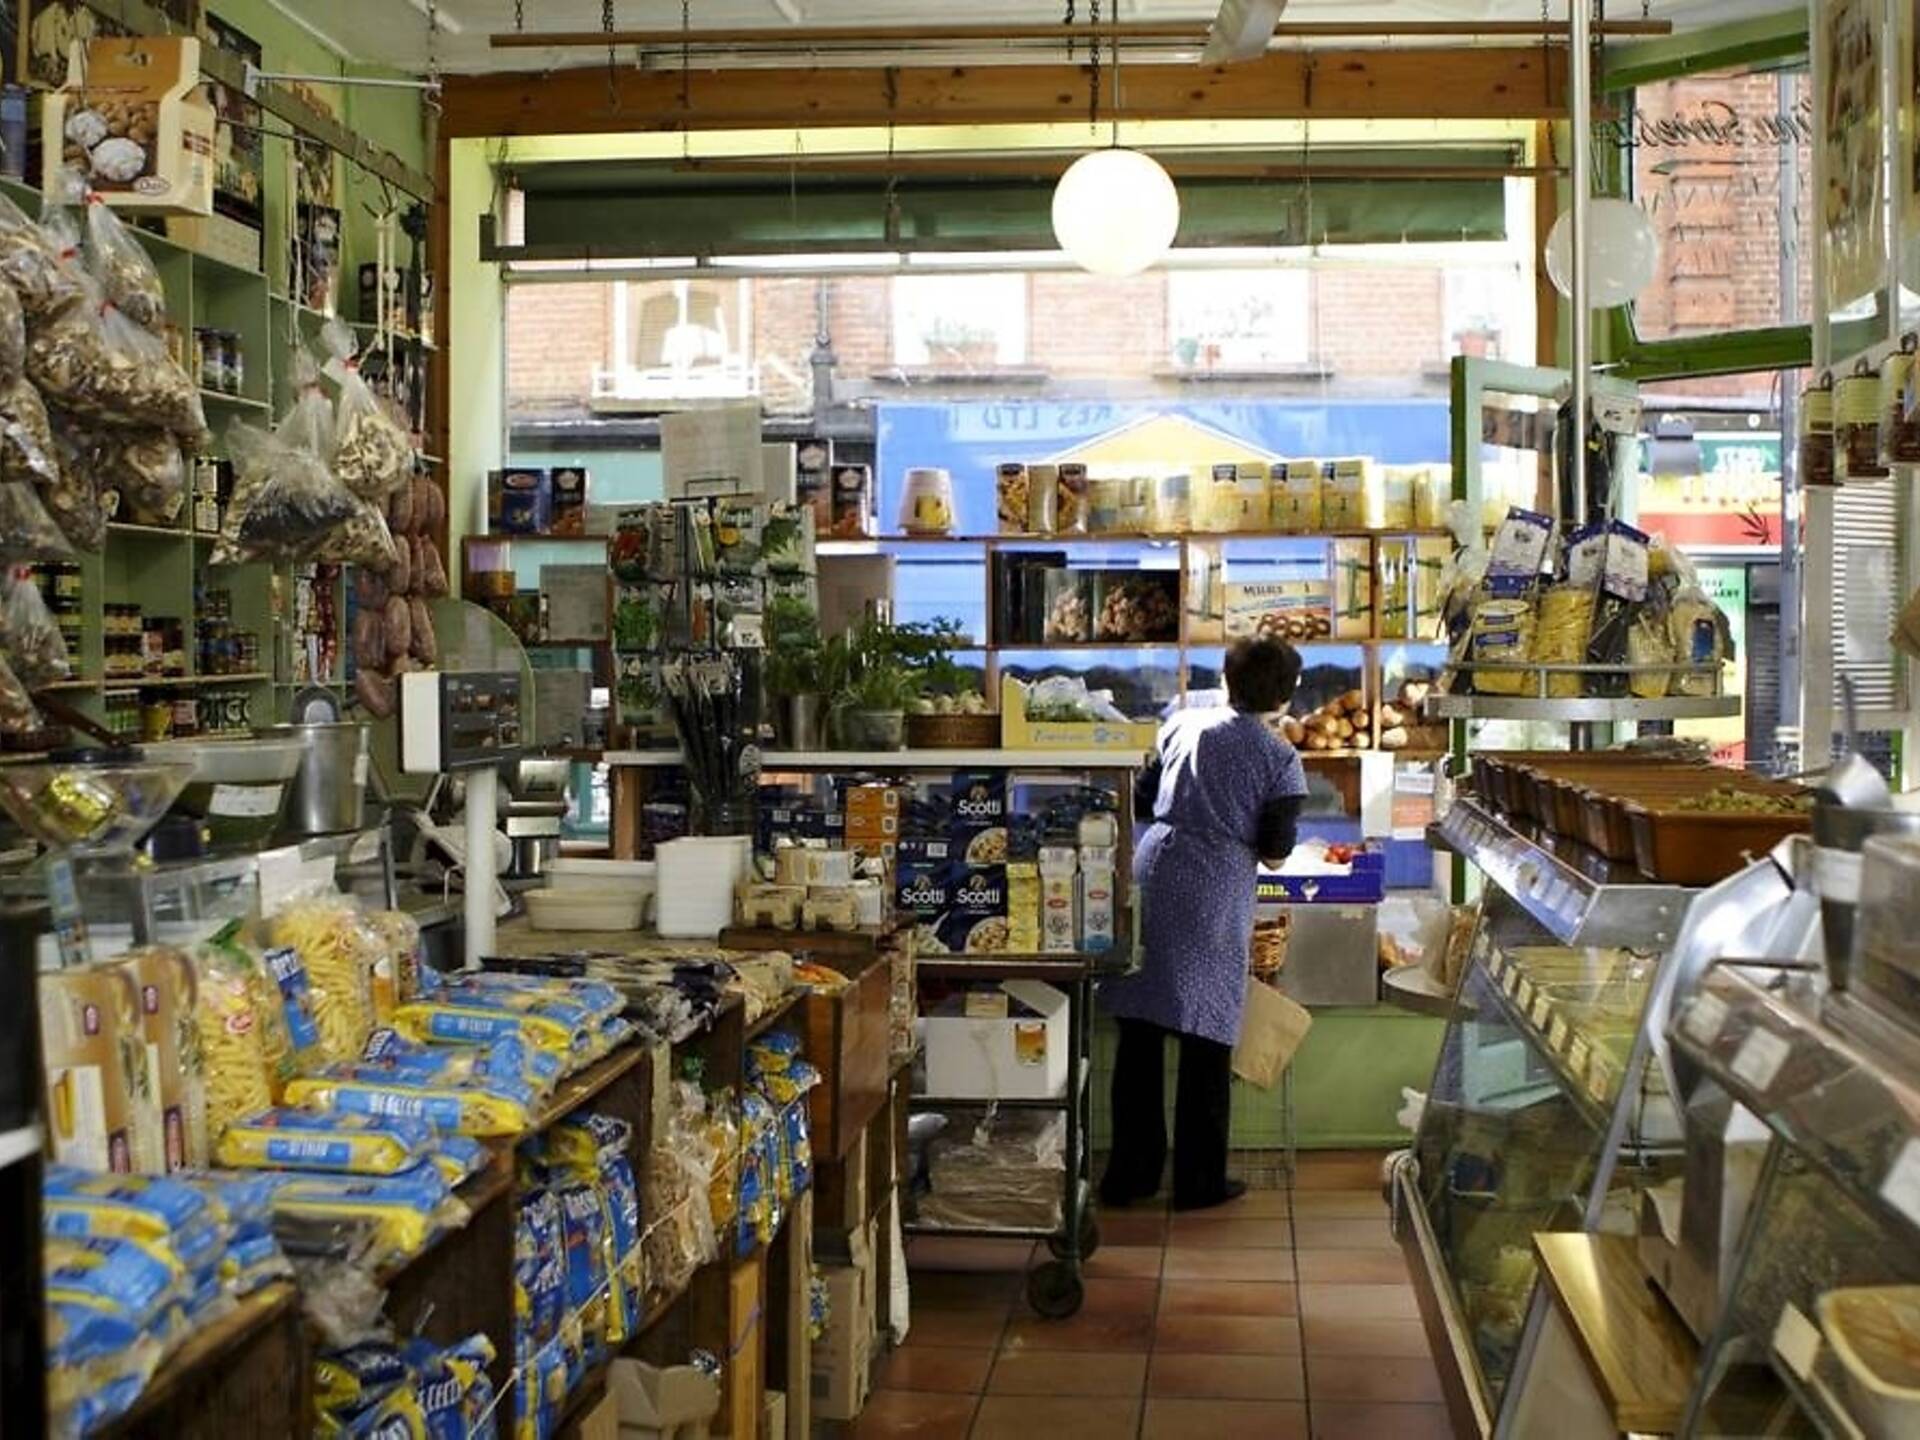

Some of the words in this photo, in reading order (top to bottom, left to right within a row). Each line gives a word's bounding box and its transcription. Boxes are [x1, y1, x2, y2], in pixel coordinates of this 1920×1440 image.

[957, 799, 1001, 815] Scotti
[901, 889, 944, 904] Scotti
[957, 889, 1000, 904] Scotti
